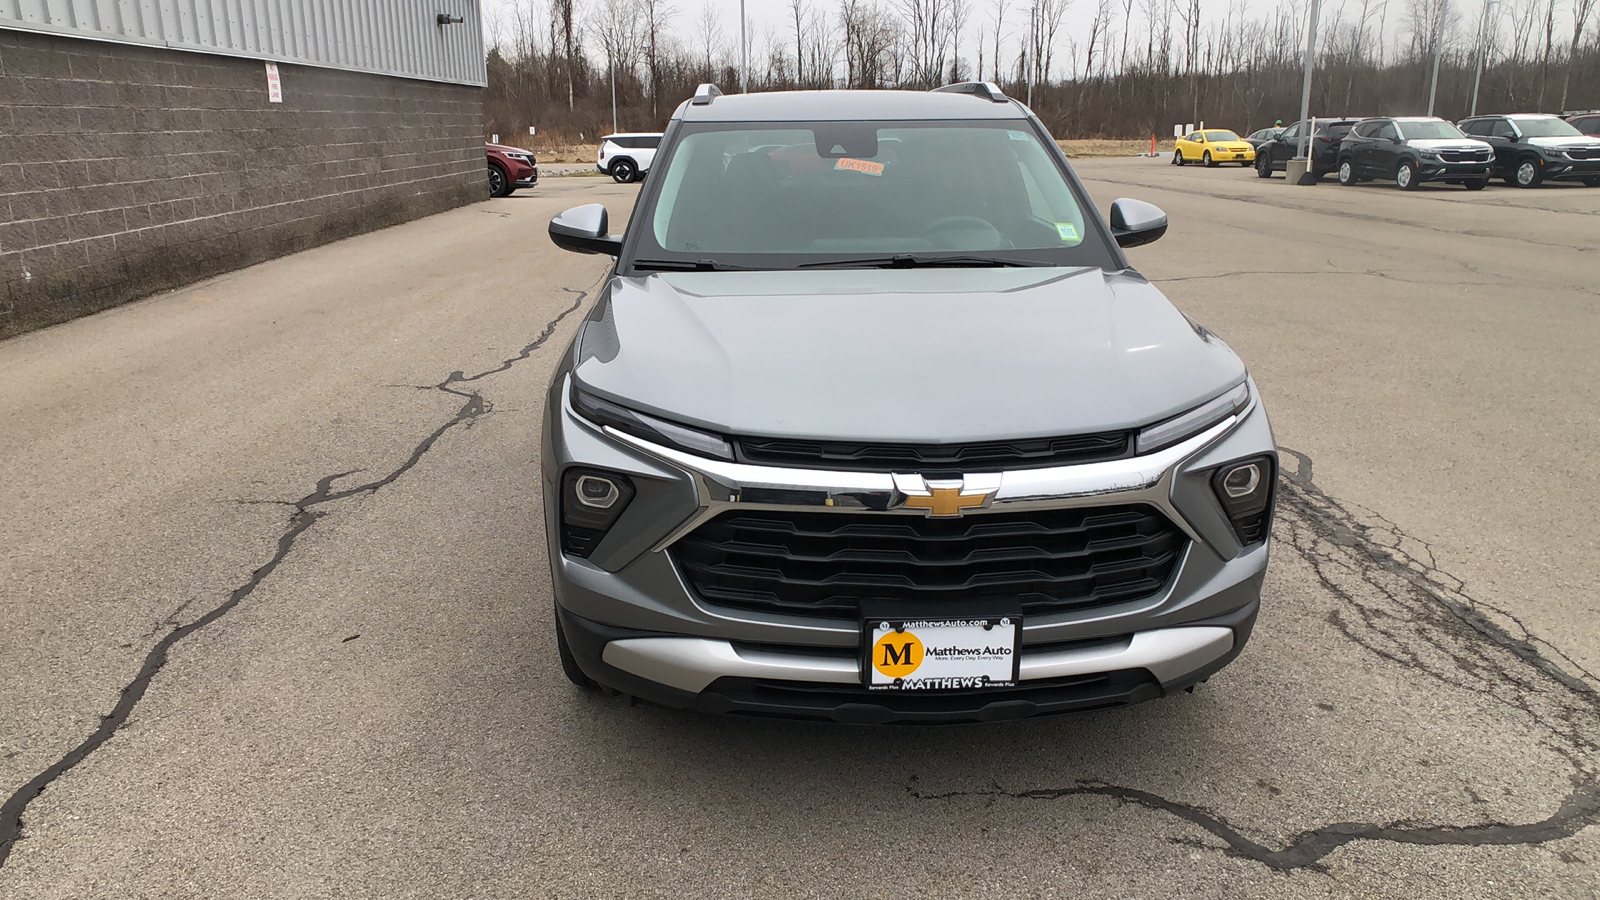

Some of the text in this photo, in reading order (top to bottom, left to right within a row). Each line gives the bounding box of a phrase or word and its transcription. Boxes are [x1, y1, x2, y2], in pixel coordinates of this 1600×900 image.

[840, 160, 878, 172] UK1519
[902, 620, 988, 629] MatthewsAuto.com
[880, 642, 915, 666] M
[925, 645, 1012, 656] Matthews Auto
[901, 678, 983, 690] MATTHEWS
